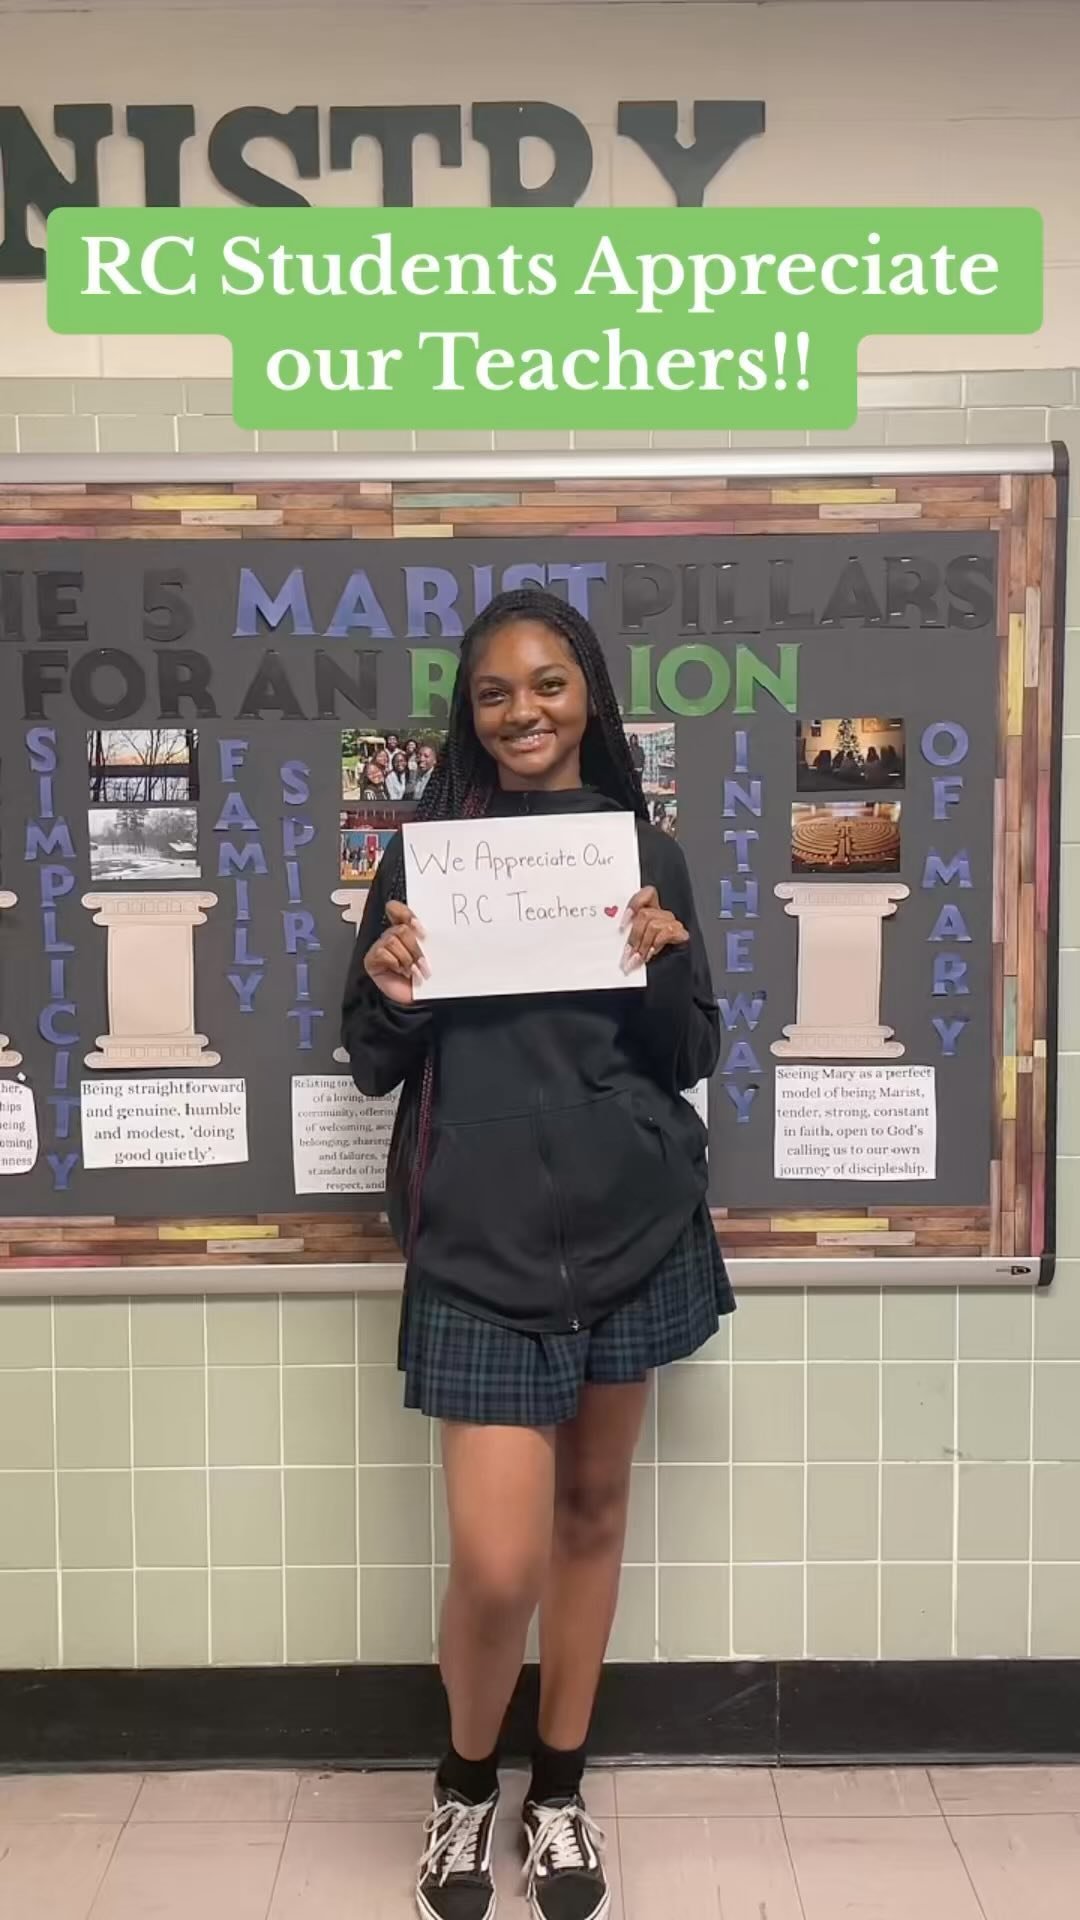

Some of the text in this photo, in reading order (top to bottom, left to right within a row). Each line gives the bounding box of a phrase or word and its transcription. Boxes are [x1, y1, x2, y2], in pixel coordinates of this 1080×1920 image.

[142, 567, 196, 642] 5
[617, 554, 996, 636] PILLARS
[20, 647, 222, 721] FOR
[234, 647, 383, 721] AN
[409, 839, 615, 881] We Appreciate Our
[213, 738, 269, 1013] FAMILY
[920, 719, 974, 1057] OF MARY
[280, 759, 325, 1050] SPIRIT
[506, 890, 597, 923] Teachers
[24, 727, 82, 1191] SIMPLICITY
[776, 1067, 933, 1082] Seeing Mary as a perfect
[82, 1080, 244, 1097] Being straightforward
[781, 1086, 925, 1100] model of being Marist,
[86, 1102, 241, 1120] and genuine, humble
[776, 1106, 929, 1119] tender, strong, constant
[94, 1126, 121, 1140] and
[127, 1126, 185, 1140] modest,
[783, 1126, 796, 1137] in
[836, 1128, 868, 1139] open
[871, 1126, 884, 1136] to
[886, 1124, 924, 1136] God's
[115, 1148, 151, 1164] good
[786, 1143, 921, 1157] calling us to our own
[779, 1161, 928, 1177] journey of discipleship.
